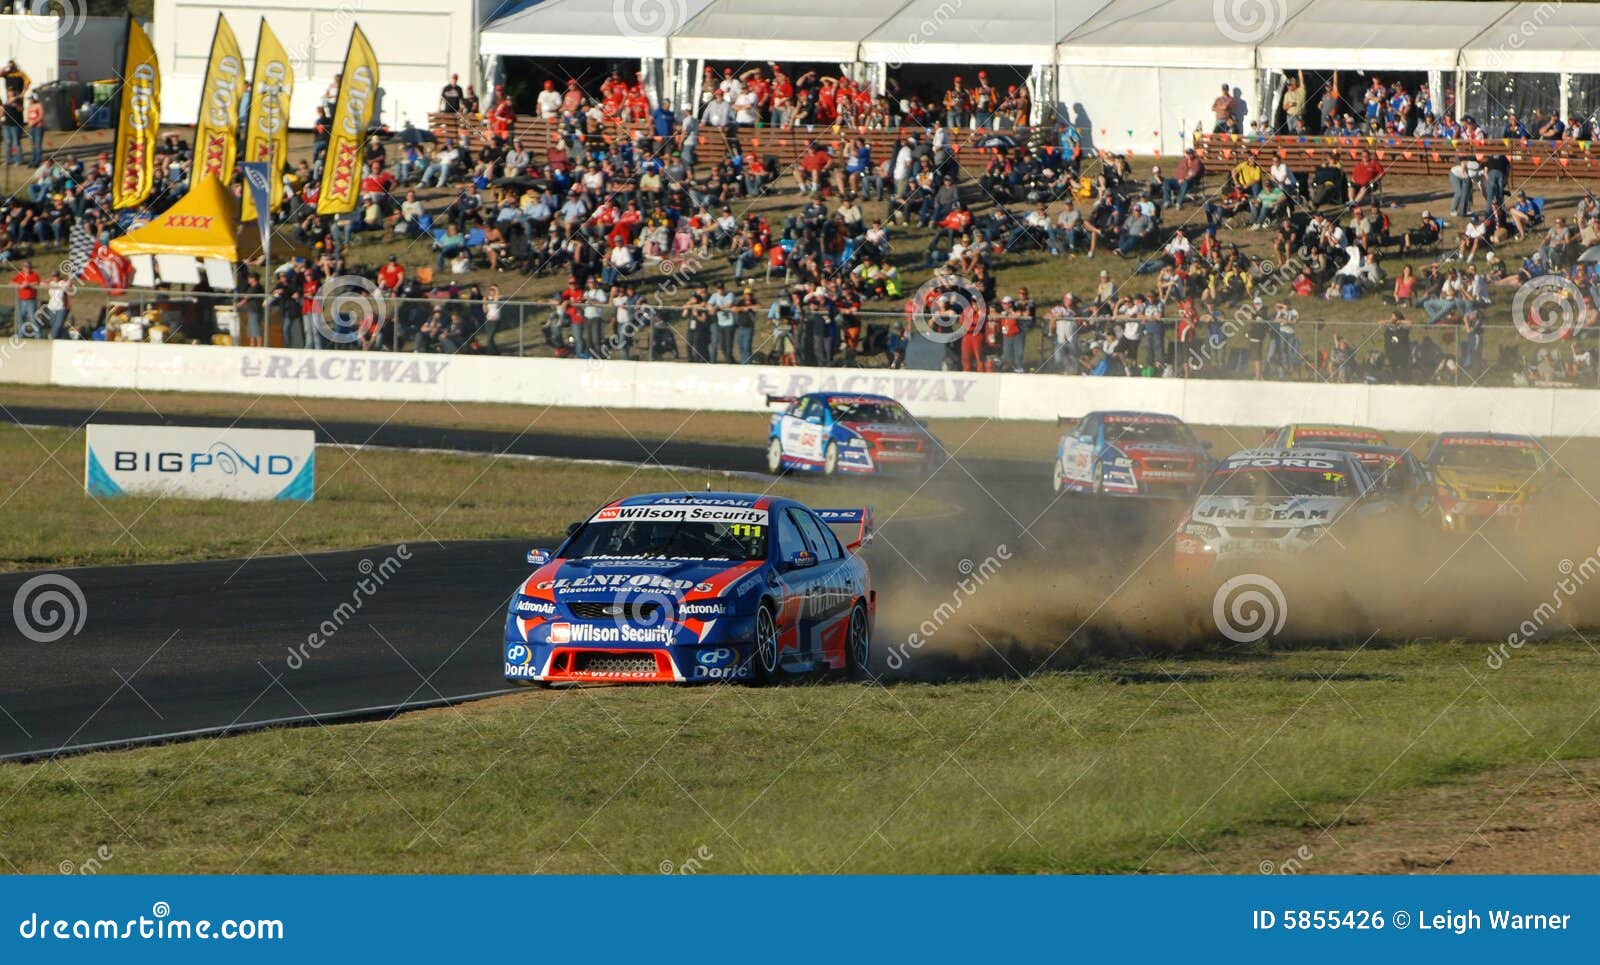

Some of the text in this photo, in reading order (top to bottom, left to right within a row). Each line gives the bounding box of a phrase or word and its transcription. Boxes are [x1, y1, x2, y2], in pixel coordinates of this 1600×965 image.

[129, 63, 155, 130] GOLD
[209, 55, 240, 127] GOLD
[343, 65, 373, 135] GOLD
[206, 134, 225, 177] XXX
[122, 140, 145, 193] XXXX
[332, 143, 359, 196] XXXX
[164, 215, 214, 229] XXXX
[264, 354, 449, 385] RACEWAY
[783, 373, 976, 402] RACEWAY
[115, 449, 293, 476] BIGPOND
[1228, 458, 1335, 469] FORD
[1322, 472, 1344, 482] 17
[619, 507, 766, 522] Wilson Security
[1198, 506, 1329, 520] JIM BEAM
[730, 524, 761, 537] 111
[536, 573, 715, 593] GLENFORDS
[559, 585, 678, 596] Discount Tool Centres
[517, 601, 556, 614] ActronAir
[679, 604, 727, 614] ActronAir
[571, 624, 674, 647] Wilson Security
[505, 663, 537, 676] Doric
[694, 665, 748, 678] Doric
